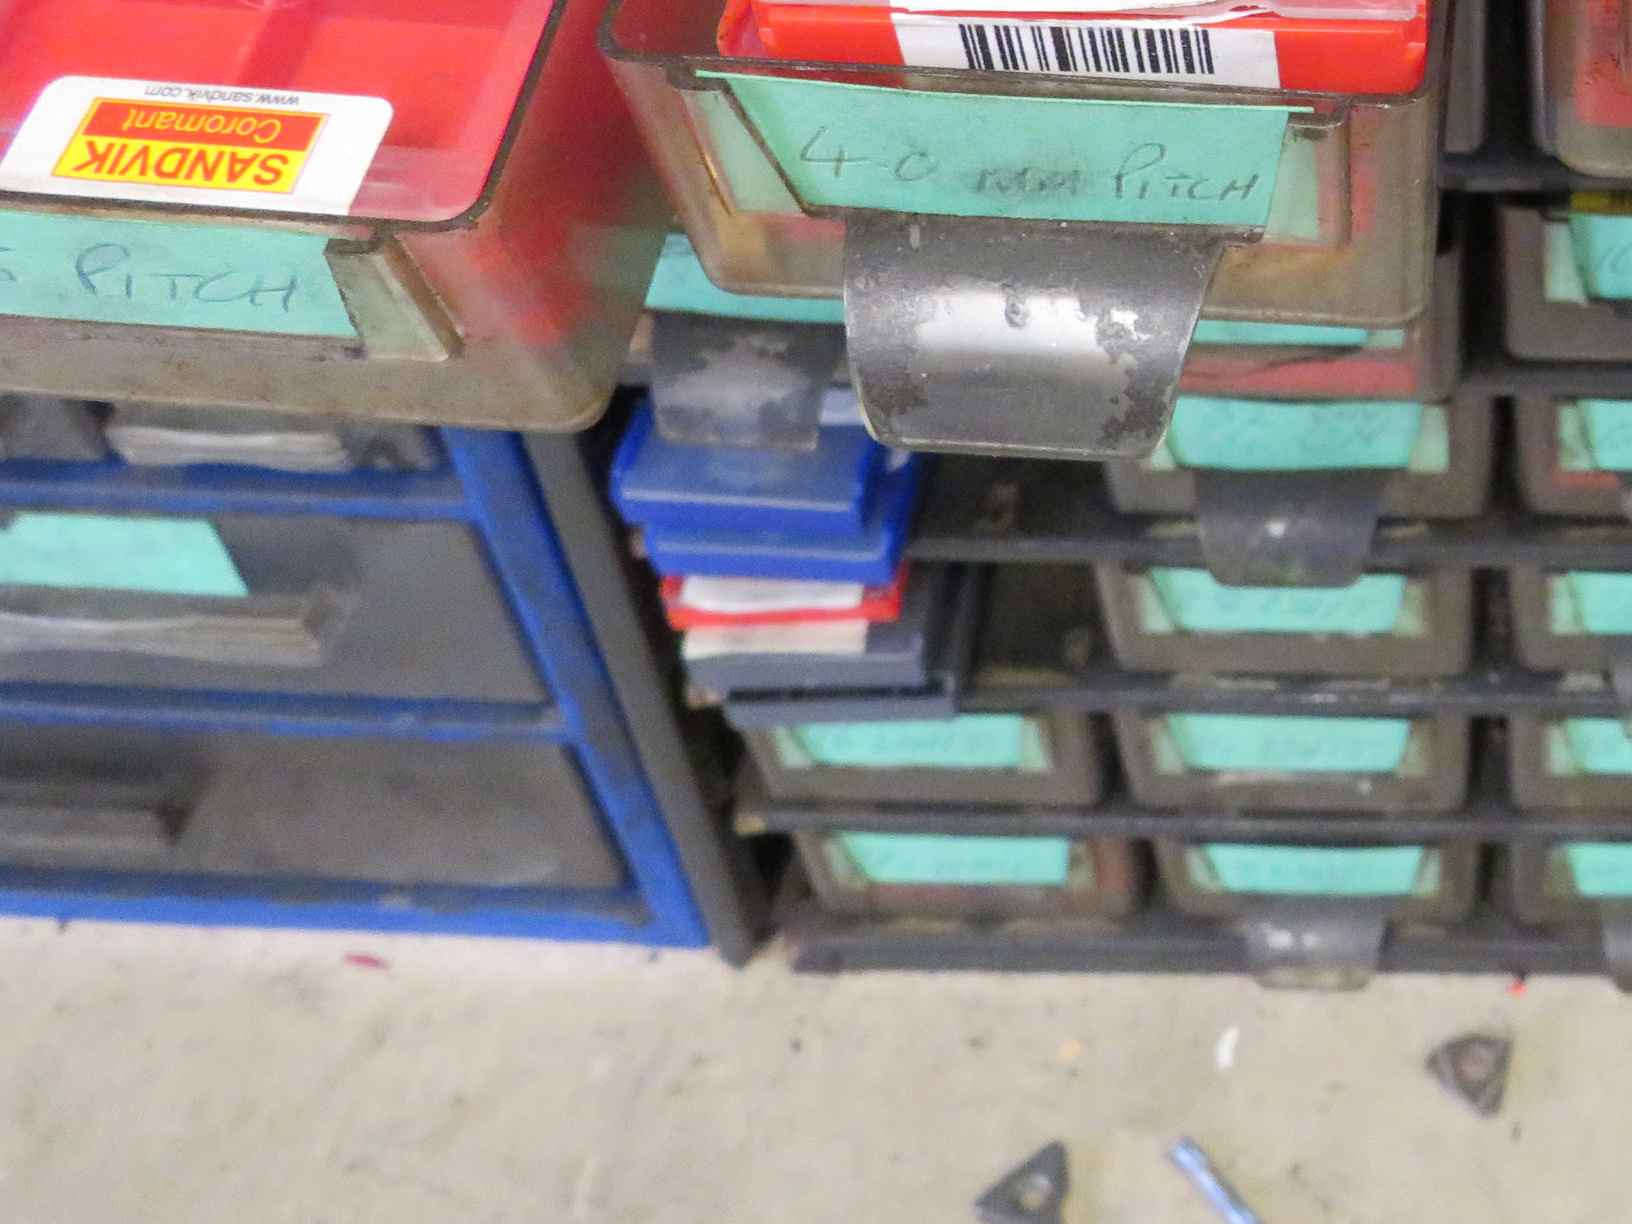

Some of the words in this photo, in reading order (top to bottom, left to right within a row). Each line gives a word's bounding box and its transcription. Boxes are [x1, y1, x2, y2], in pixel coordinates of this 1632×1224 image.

[144, 85, 301, 107] www.sandvik.com
[121, 108, 282, 143] Coromant
[73, 139, 290, 186] SANDVIK
